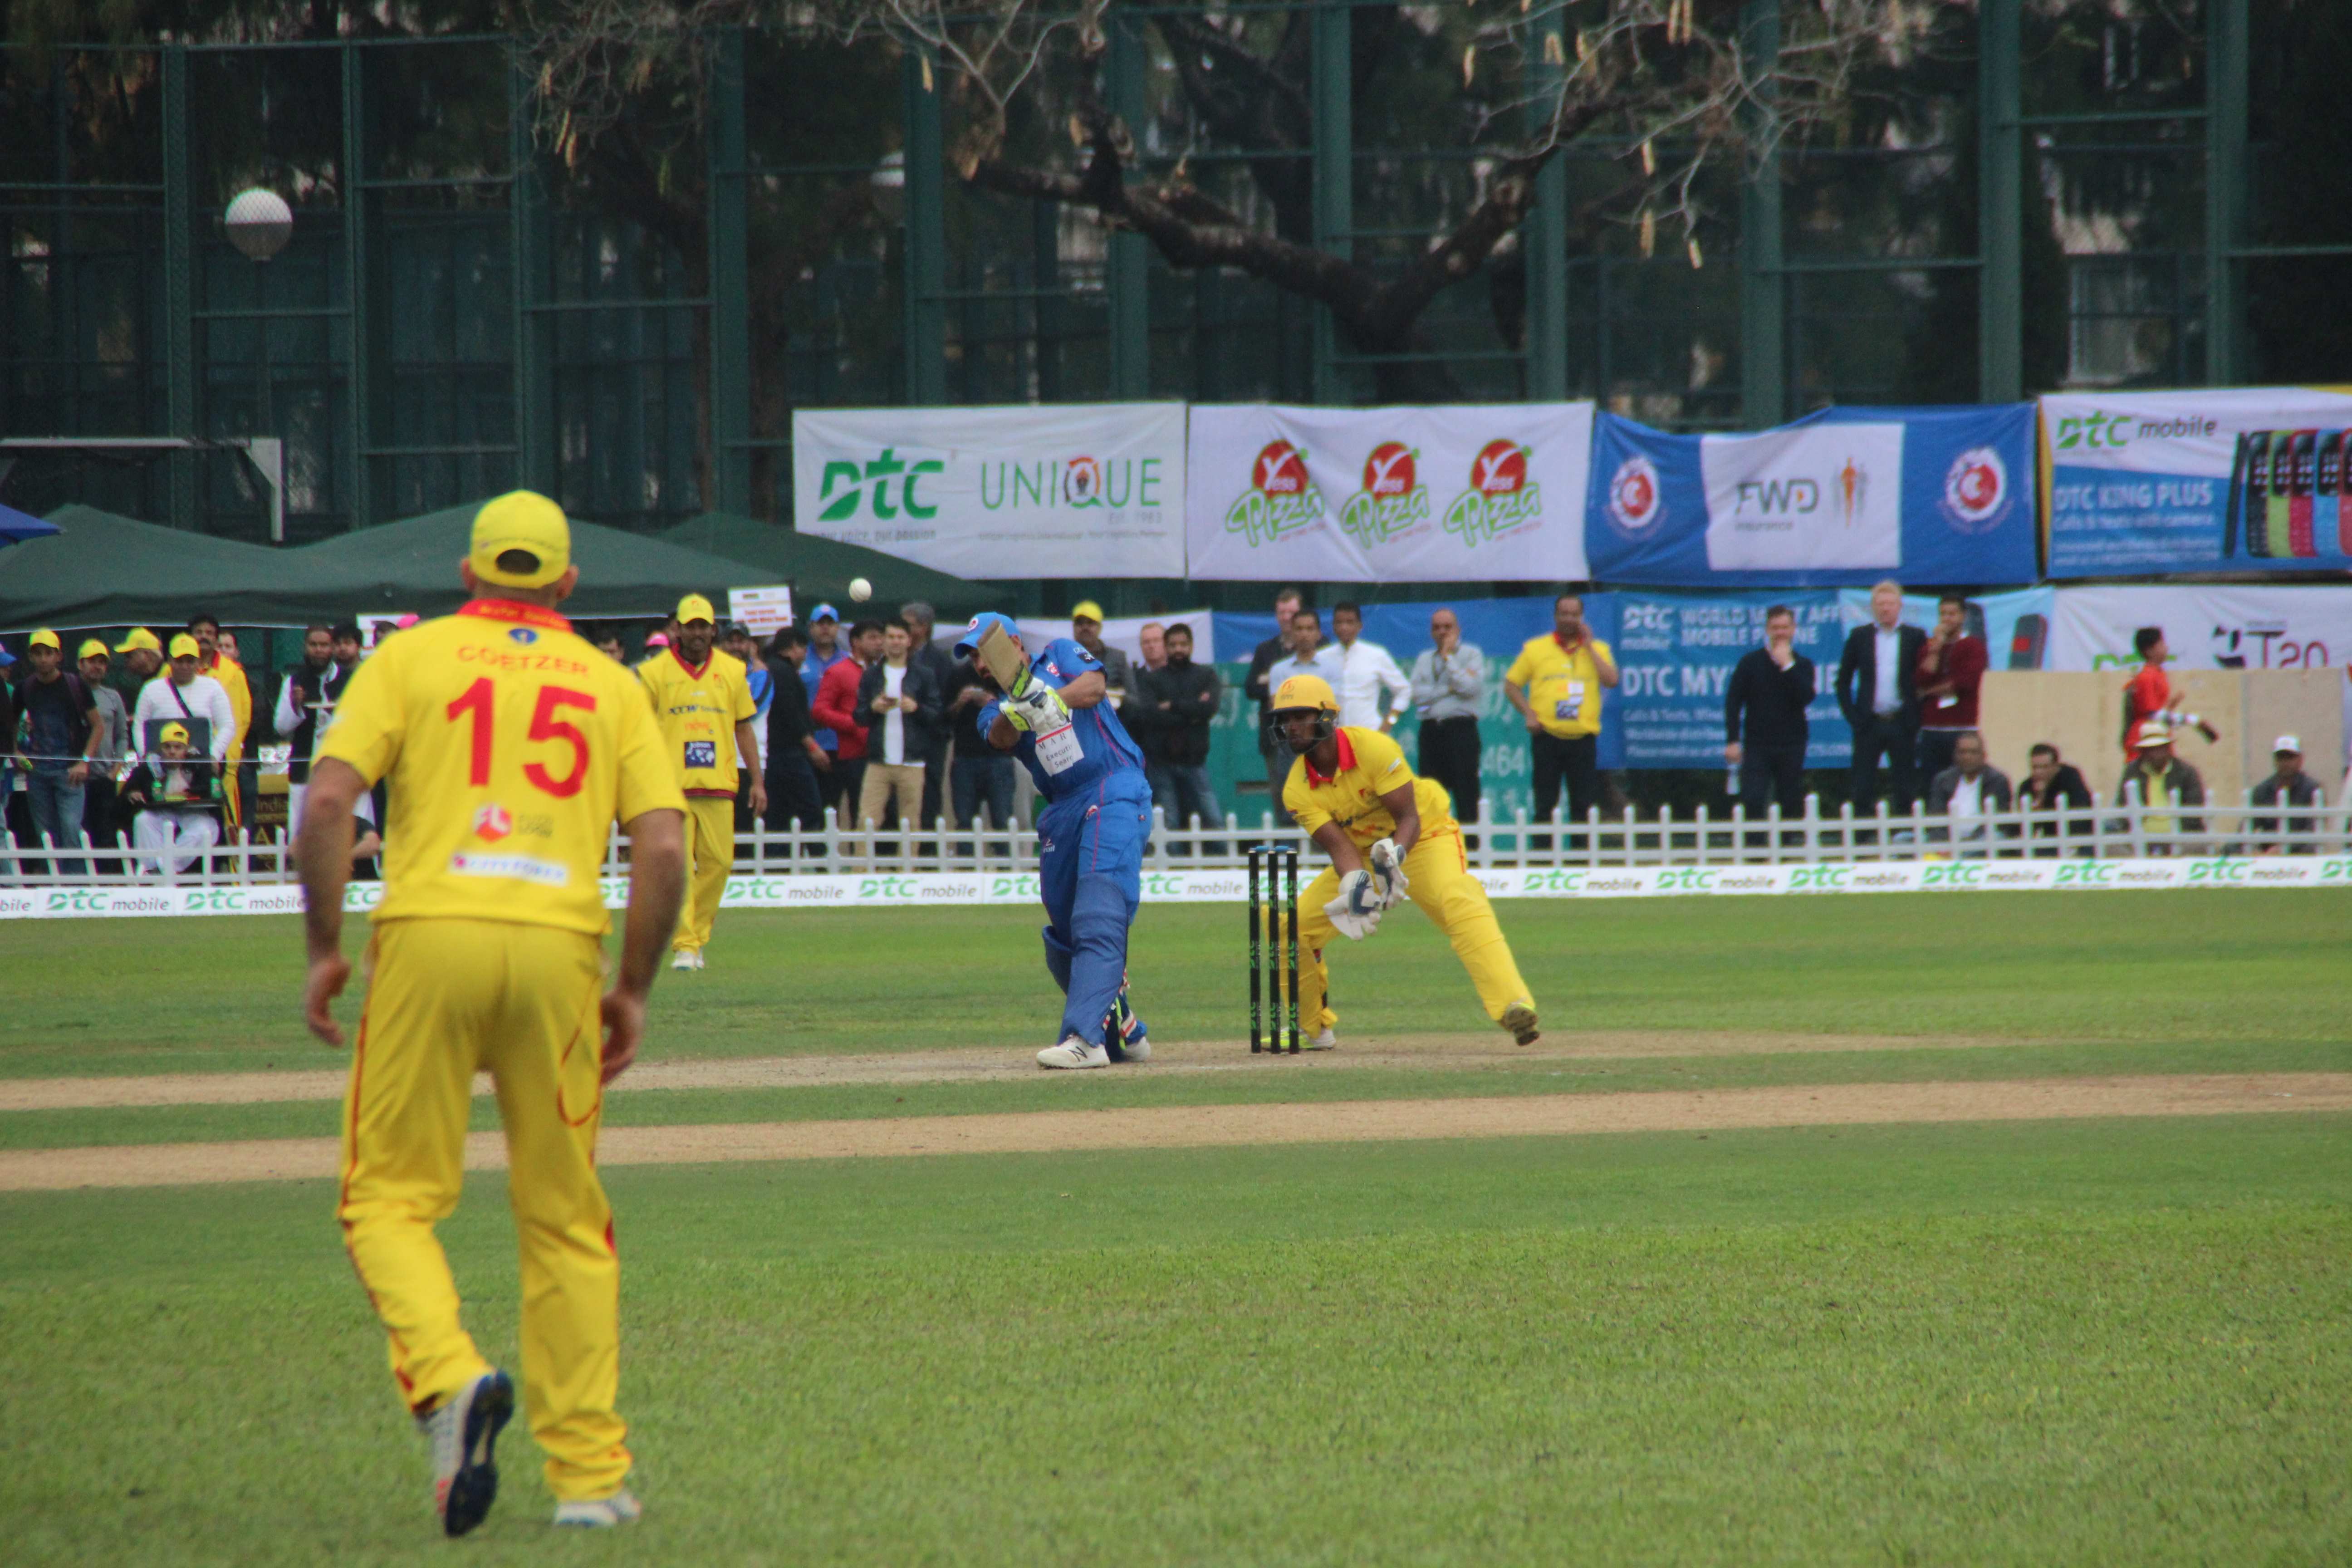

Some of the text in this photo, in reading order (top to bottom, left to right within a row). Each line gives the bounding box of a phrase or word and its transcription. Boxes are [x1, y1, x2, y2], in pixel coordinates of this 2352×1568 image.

[2137, 416, 2217, 439] mobile
[981, 456, 1162, 510] UNIQUE
[1736, 479, 1820, 514] FWD
[2156, 481, 2213, 506] PLUS
[1681, 627, 1747, 646] MOBILE
[457, 644, 589, 676] COETZER
[1622, 666, 1675, 696] DTC
[446, 677, 597, 799] 15
[921, 884, 977, 898] mobile
[1187, 882, 1243, 895] mobile
[1587, 877, 1642, 891] mobile
[1720, 876, 1774, 888] mobile
[789, 885, 843, 899] mobile
[112, 898, 170, 911] mobile
[249, 896, 306, 909] mobile
